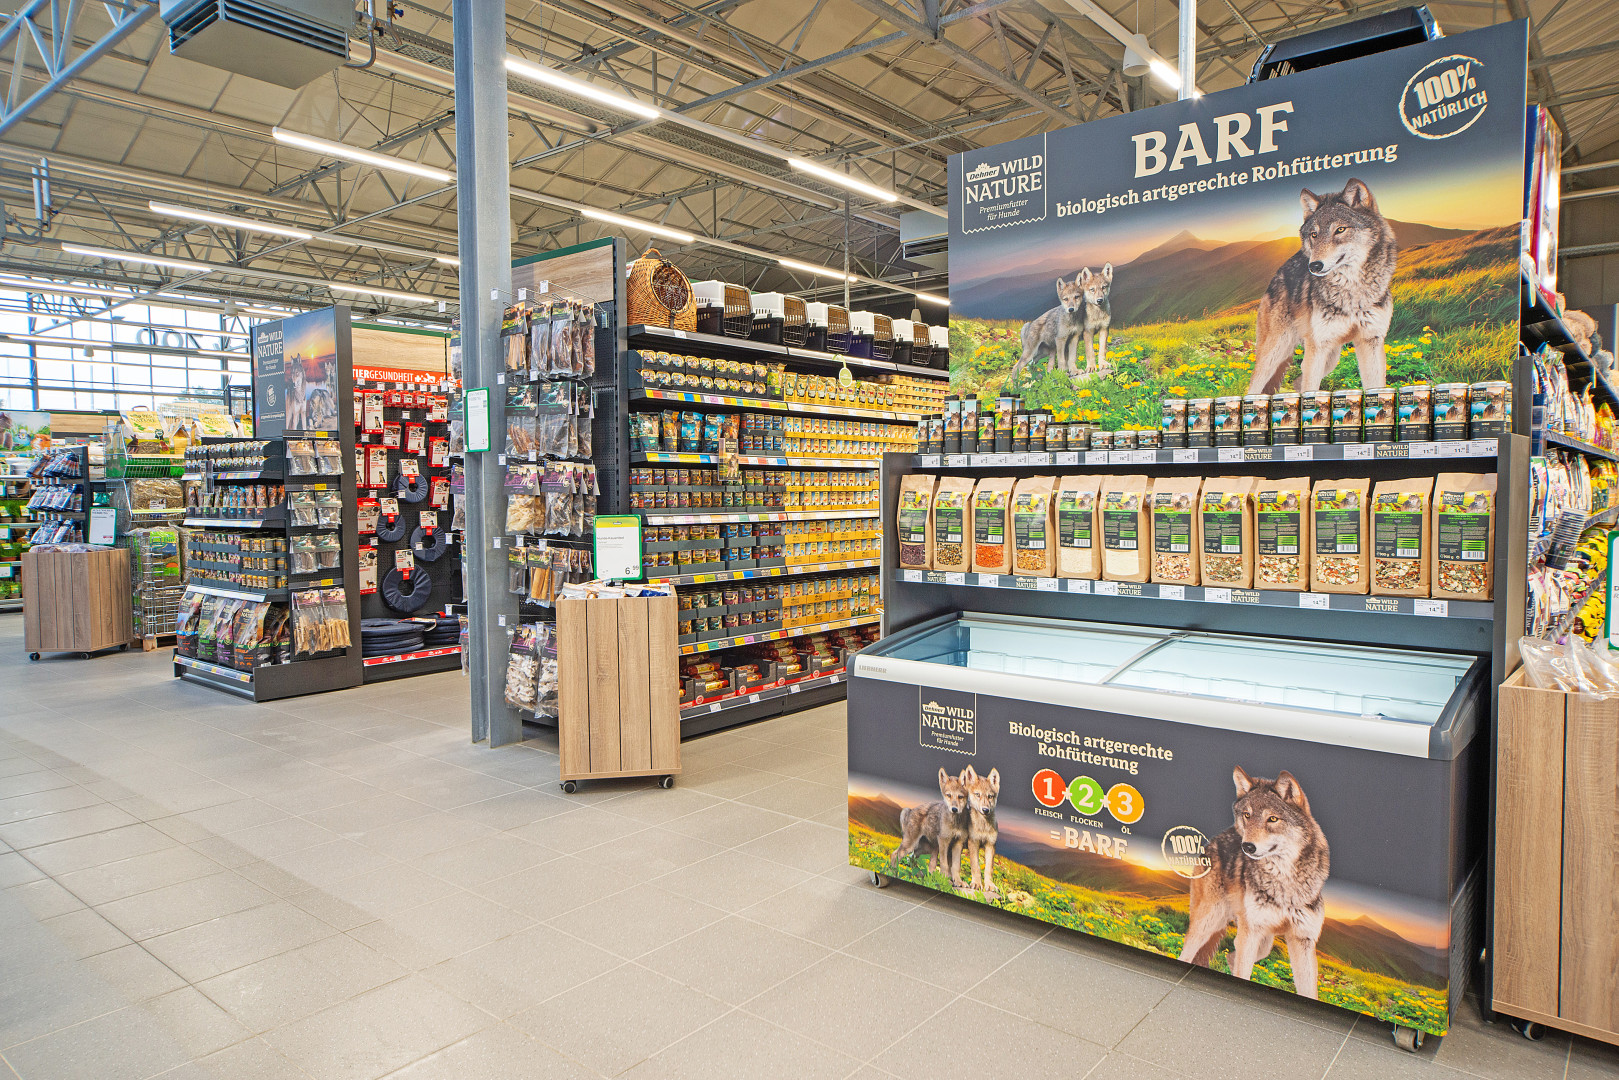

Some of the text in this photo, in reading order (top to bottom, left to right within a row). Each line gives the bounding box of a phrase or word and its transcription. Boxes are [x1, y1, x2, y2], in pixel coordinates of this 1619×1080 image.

[1413, 61, 1477, 110] 100%
[1412, 90, 1488, 129] NATÜRLICH
[1131, 101, 1295, 178] BARF
[969, 155, 1043, 181] Dehner WILD
[966, 171, 1042, 205] NATURE
[1056, 144, 1399, 218] biologisch artgerechte Rohfütterung
[979, 199, 1029, 214] Premiumfutter
[987, 208, 1020, 221] für Hunde
[269, 330, 283, 341] WILD
[257, 341, 283, 358] NATURE
[352, 368, 414, 382] TIERGESUNDHEIT
[1231, 595, 1260, 603] NATURE
[1365, 603, 1399, 612] NATURE
[858, 664, 887, 674] LIEBHERR
[921, 713, 974, 735] NATURE
[945, 706, 974, 720] WILD
[1009, 721, 1173, 761] Biologisch artgerechte
[1037, 742, 1139, 775] Rohfütterung
[1043, 777, 1056, 801] 1
[1078, 784, 1094, 808] 2
[1117, 791, 1134, 816] 3
[1034, 807, 1132, 835] FLEISCH FLOCKEN ÖL
[1063, 826, 1129, 860] BARF
[1169, 834, 1206, 855] 100%
[1168, 853, 1212, 867] NATÜRLICH
